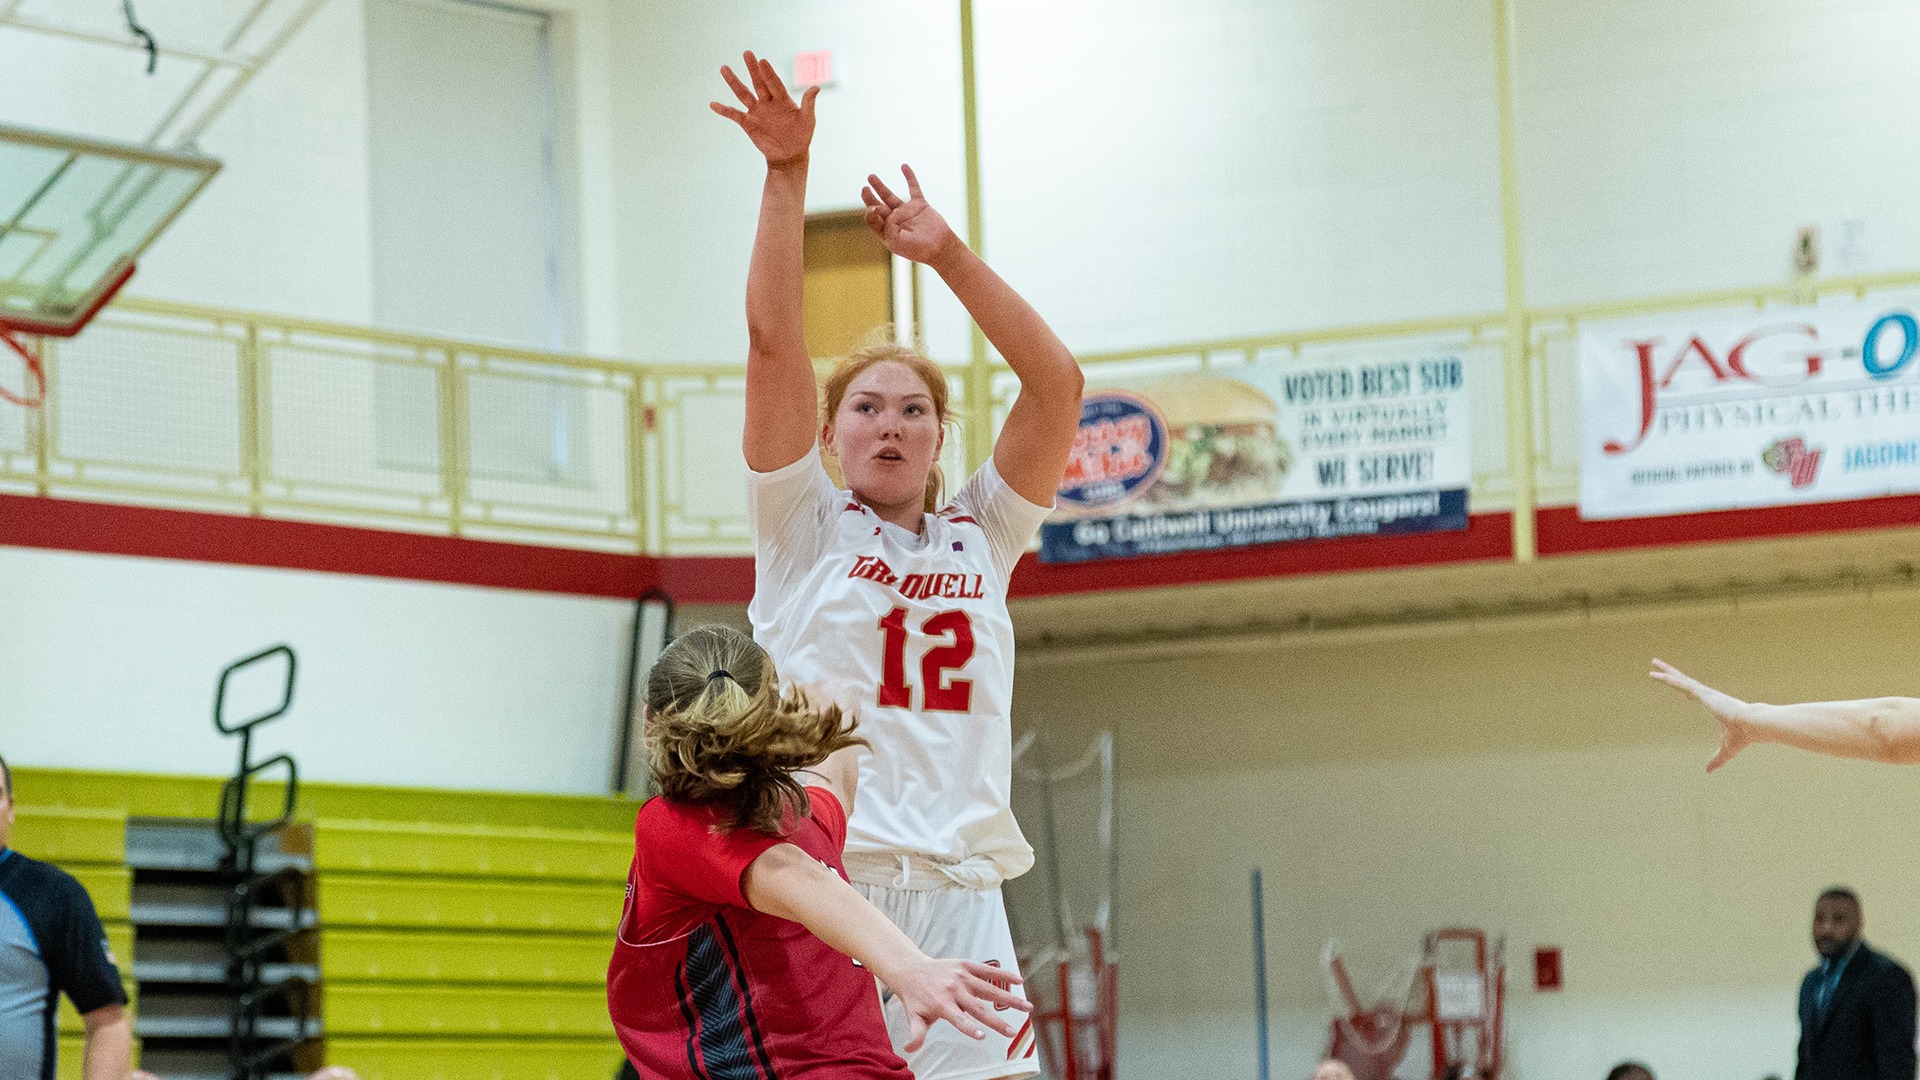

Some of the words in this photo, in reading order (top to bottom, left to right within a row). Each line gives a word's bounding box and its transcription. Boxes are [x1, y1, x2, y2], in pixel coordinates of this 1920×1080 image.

[1284, 368, 1353, 403] VOTED
[1361, 362, 1411, 396] BEST
[1420, 357, 1462, 390] SUB
[1659, 397, 1841, 434] PHYSICAL
[1317, 459, 1346, 486] WE
[1074, 521, 1110, 546] Go
[1112, 511, 1211, 543] Caldwell
[1214, 503, 1330, 536] University
[878, 604, 976, 714] 12
